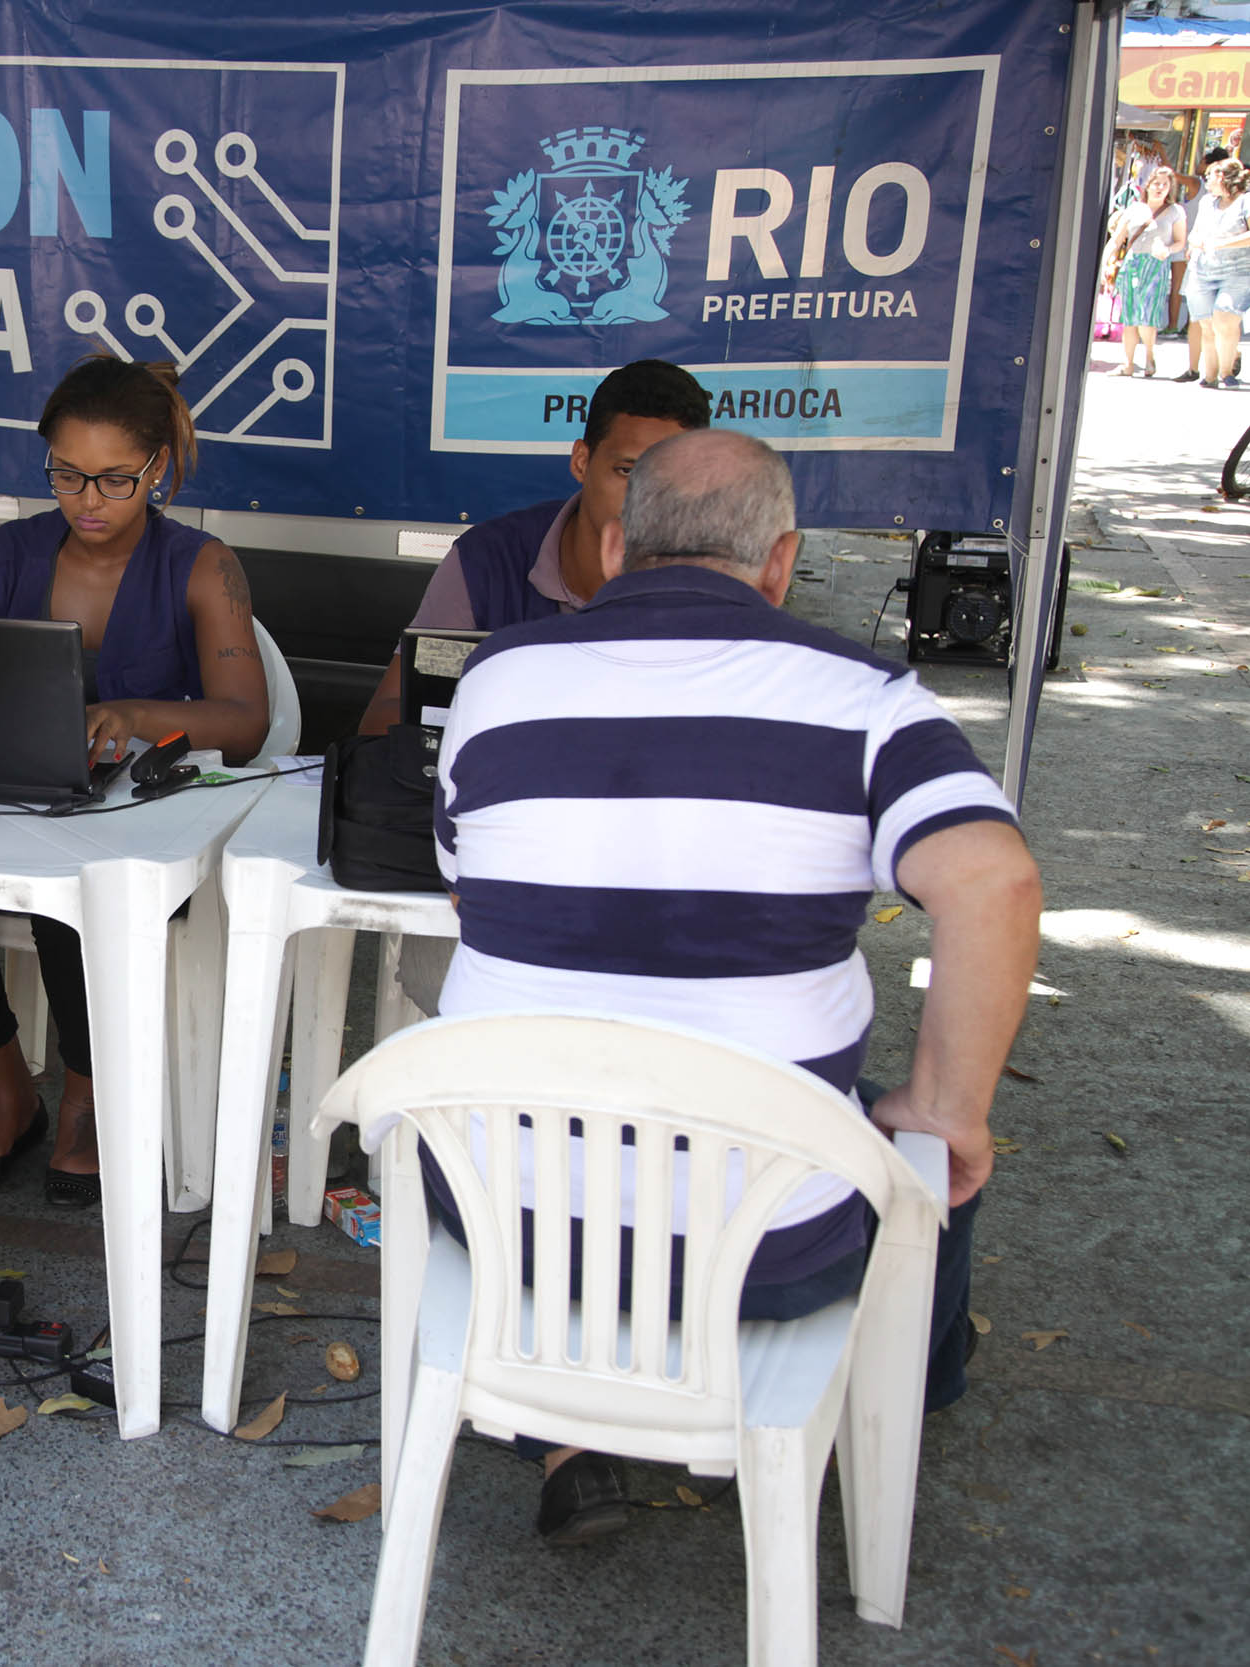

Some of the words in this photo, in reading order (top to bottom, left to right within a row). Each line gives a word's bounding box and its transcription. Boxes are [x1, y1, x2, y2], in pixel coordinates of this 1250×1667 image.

[705, 162, 931, 281] RIO
[702, 290, 918, 322] PREFEITURA
[706, 388, 843, 420] ARIOCA
